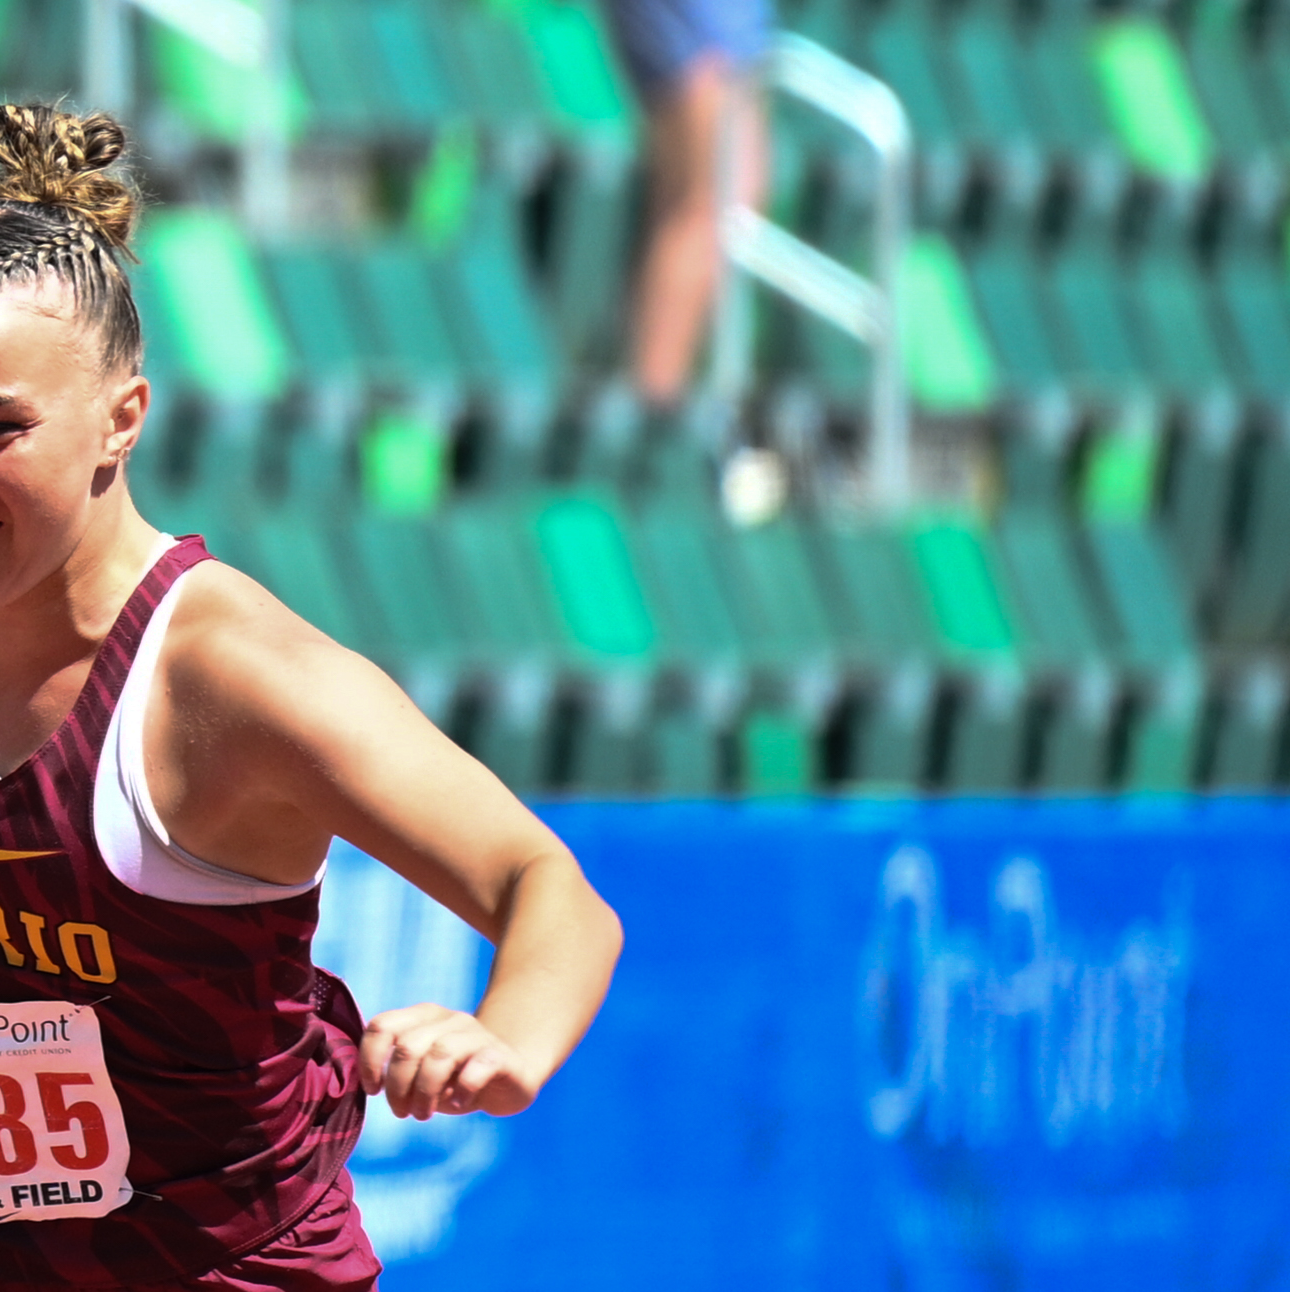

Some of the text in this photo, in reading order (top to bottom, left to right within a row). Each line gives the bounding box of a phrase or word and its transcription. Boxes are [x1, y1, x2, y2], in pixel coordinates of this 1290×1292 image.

[6, 1048, 37, 1057] CREDIT
[41, 1047, 72, 1055] UNION
[11, 1179, 104, 1209] FIELD
